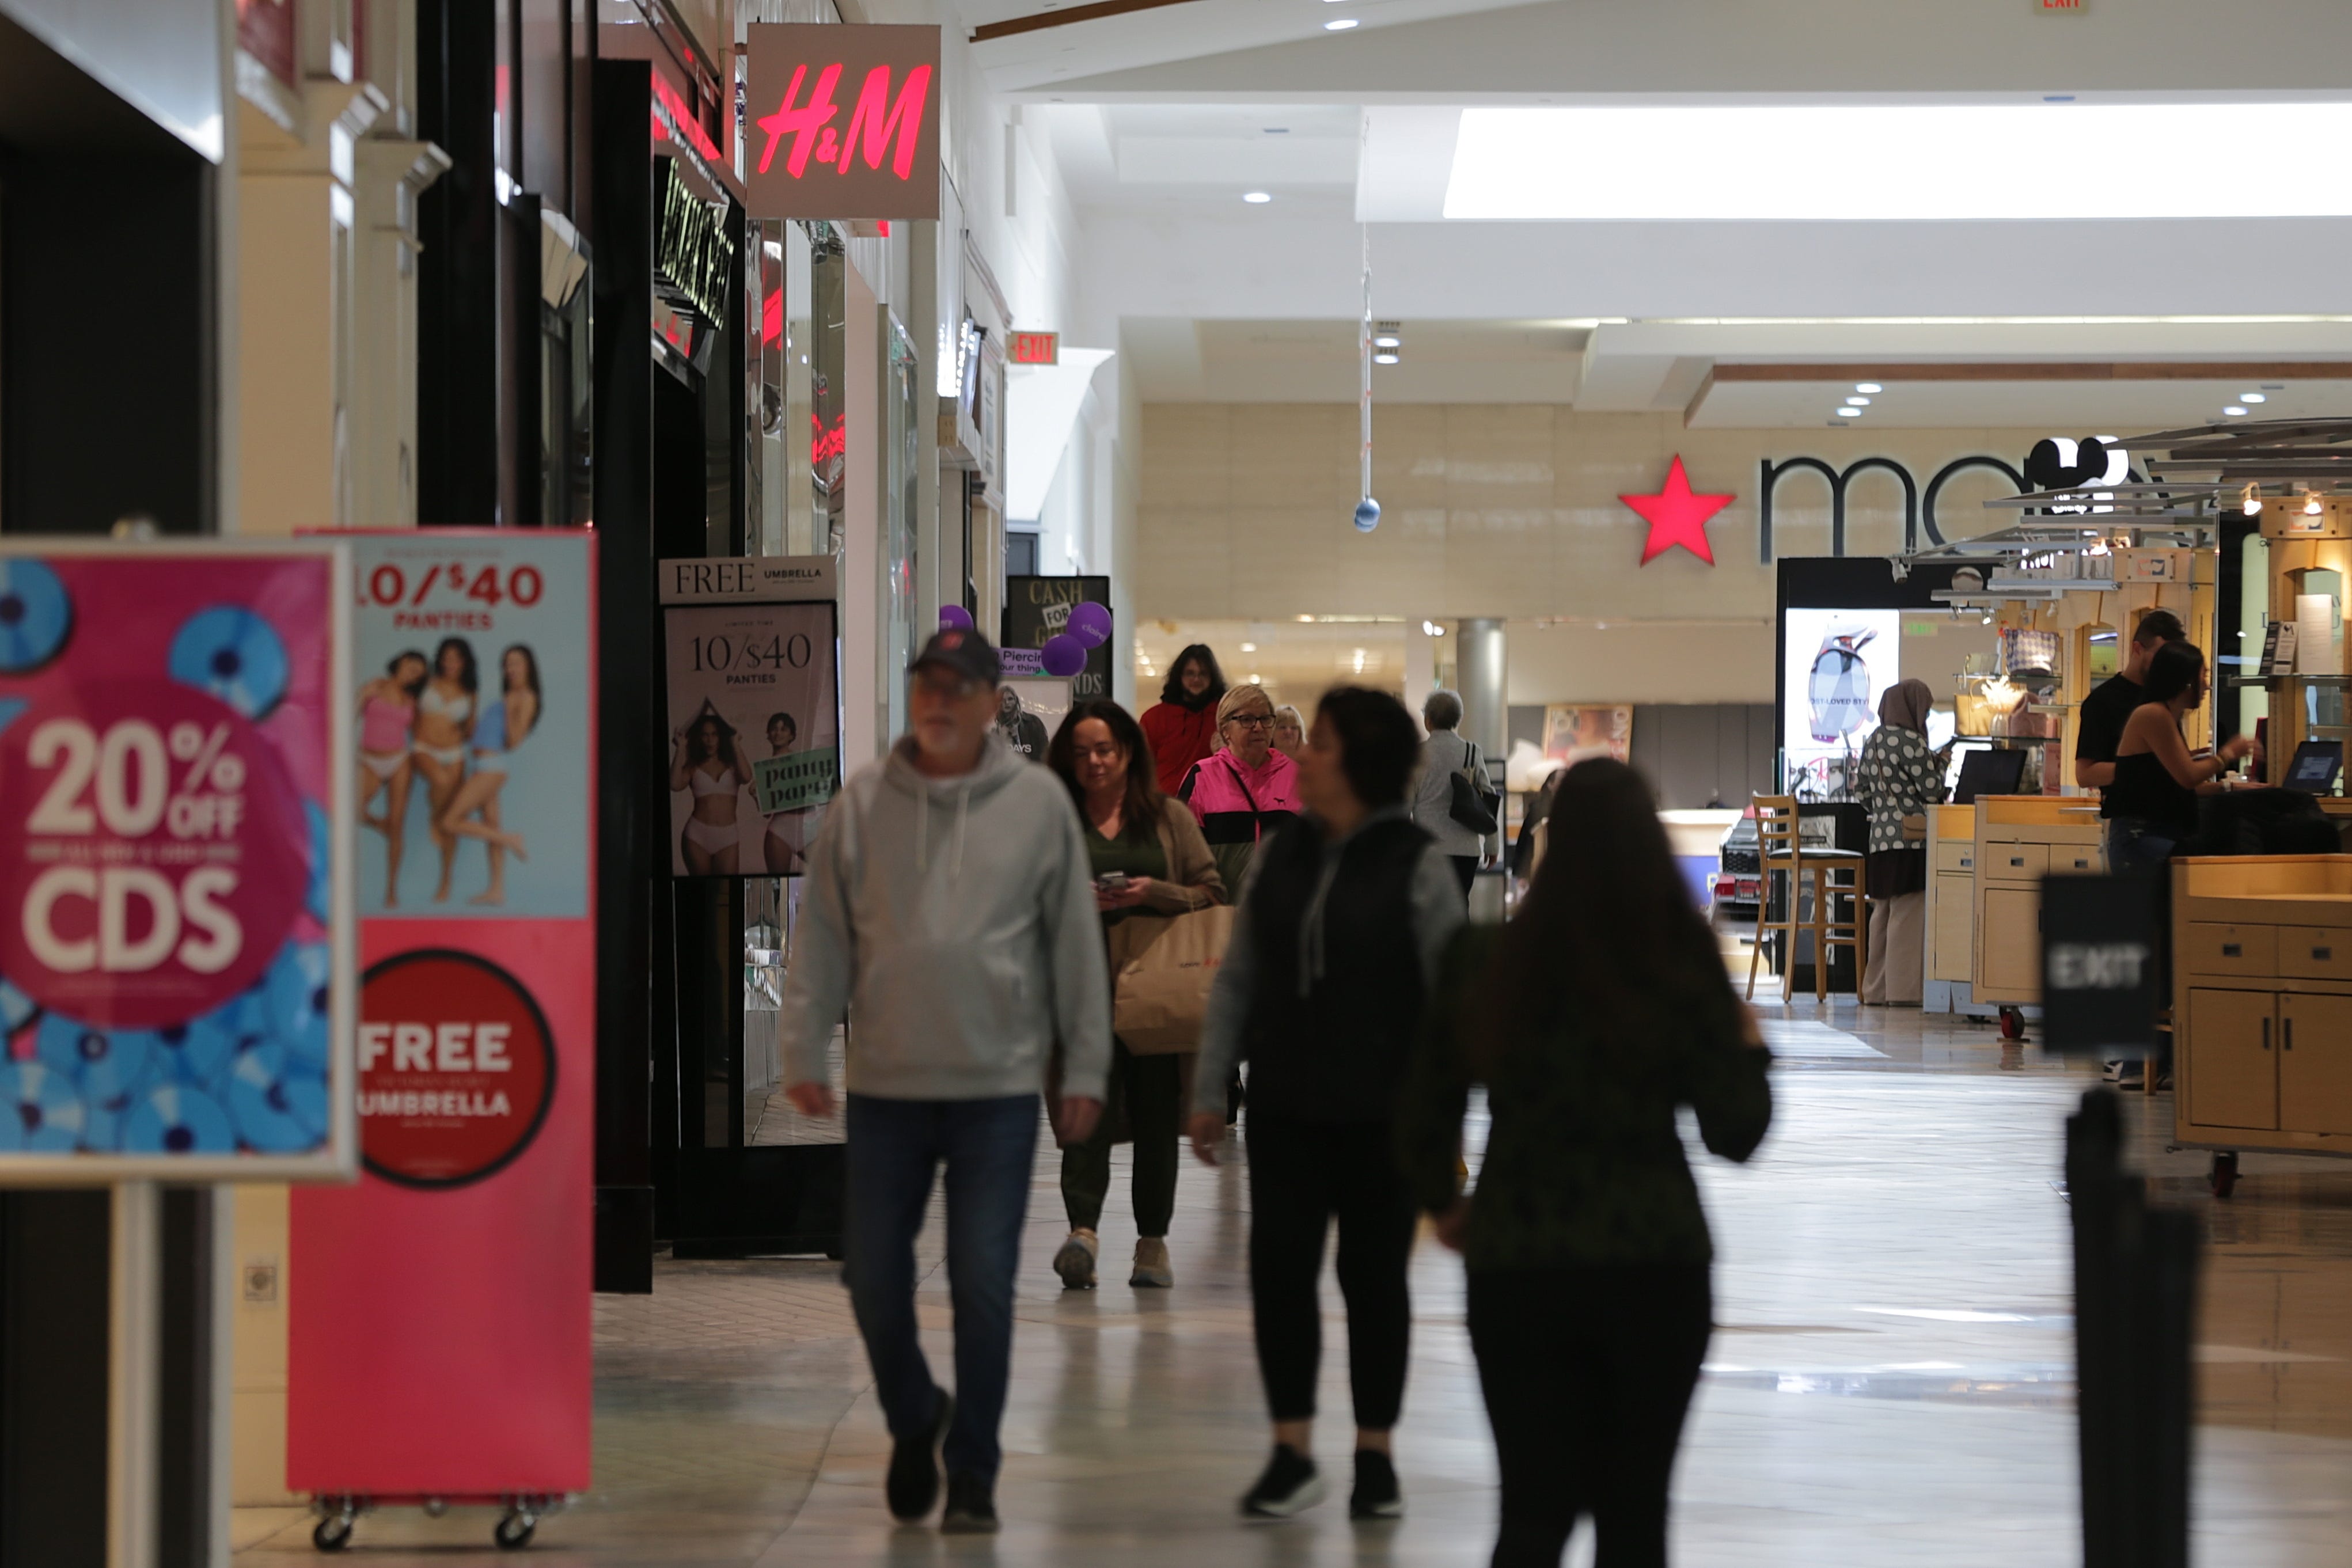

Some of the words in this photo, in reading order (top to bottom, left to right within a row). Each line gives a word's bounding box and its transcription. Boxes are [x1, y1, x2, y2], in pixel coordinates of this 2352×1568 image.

[757, 63, 932, 180] H&M
[1016, 334, 1054, 362] EXIT
[676, 563, 756, 594] FREE
[764, 568, 822, 579] UMBRELLA
[1029, 581, 1083, 603] CASH
[393, 612, 494, 630] PANTIES
[1046, 608, 1069, 625] FOR
[691, 633, 811, 671] 10/$40
[726, 674, 776, 685] PANTIES
[21, 868, 244, 974] CDS
[2048, 944, 2149, 989] EXIT
[356, 1023, 512, 1071] FREE
[356, 1092, 510, 1117] UMBRELLA
